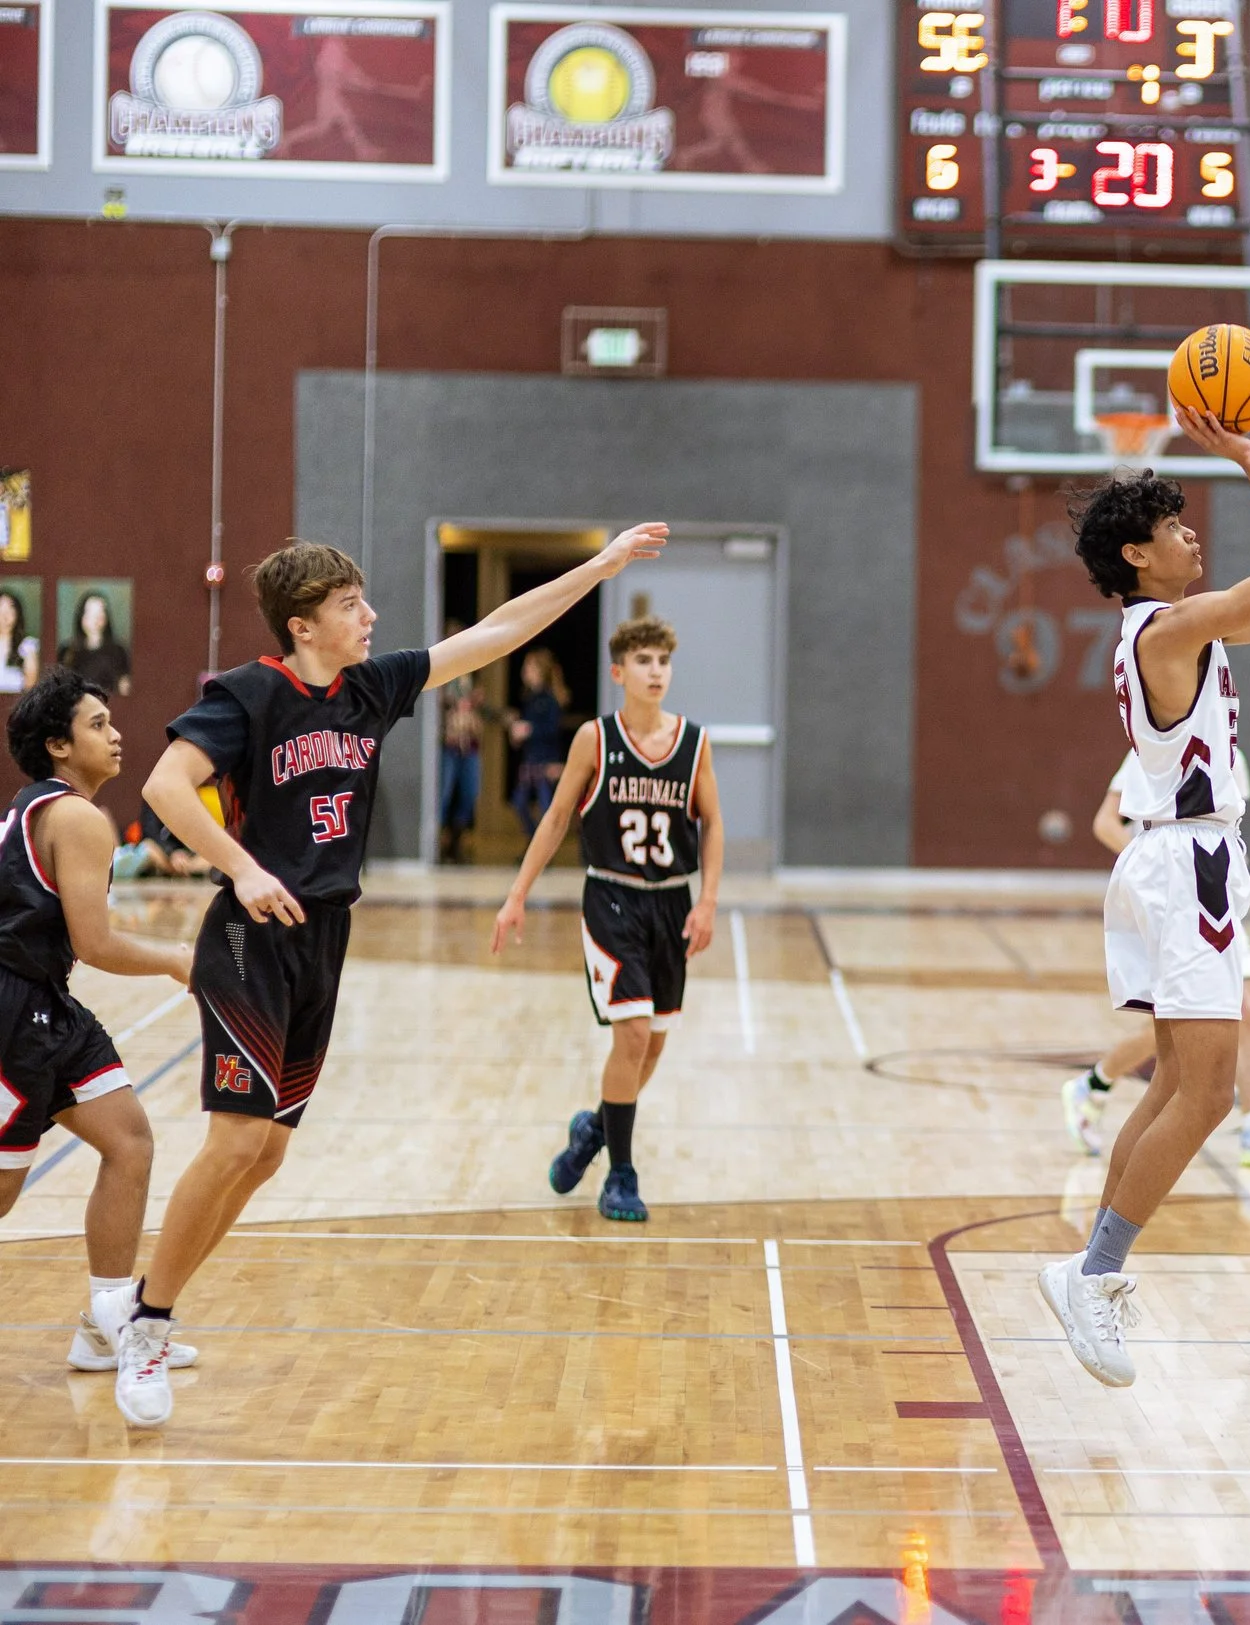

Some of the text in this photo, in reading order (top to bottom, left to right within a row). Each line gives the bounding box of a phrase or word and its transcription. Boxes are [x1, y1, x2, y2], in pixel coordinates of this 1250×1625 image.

[926, 144, 959, 190] 6
[1093, 141, 1173, 208] 20
[1200, 152, 1234, 197] 5
[272, 730, 375, 786] CARDINALS
[608, 775, 687, 809] CARDINALS
[619, 808, 675, 867] 23
